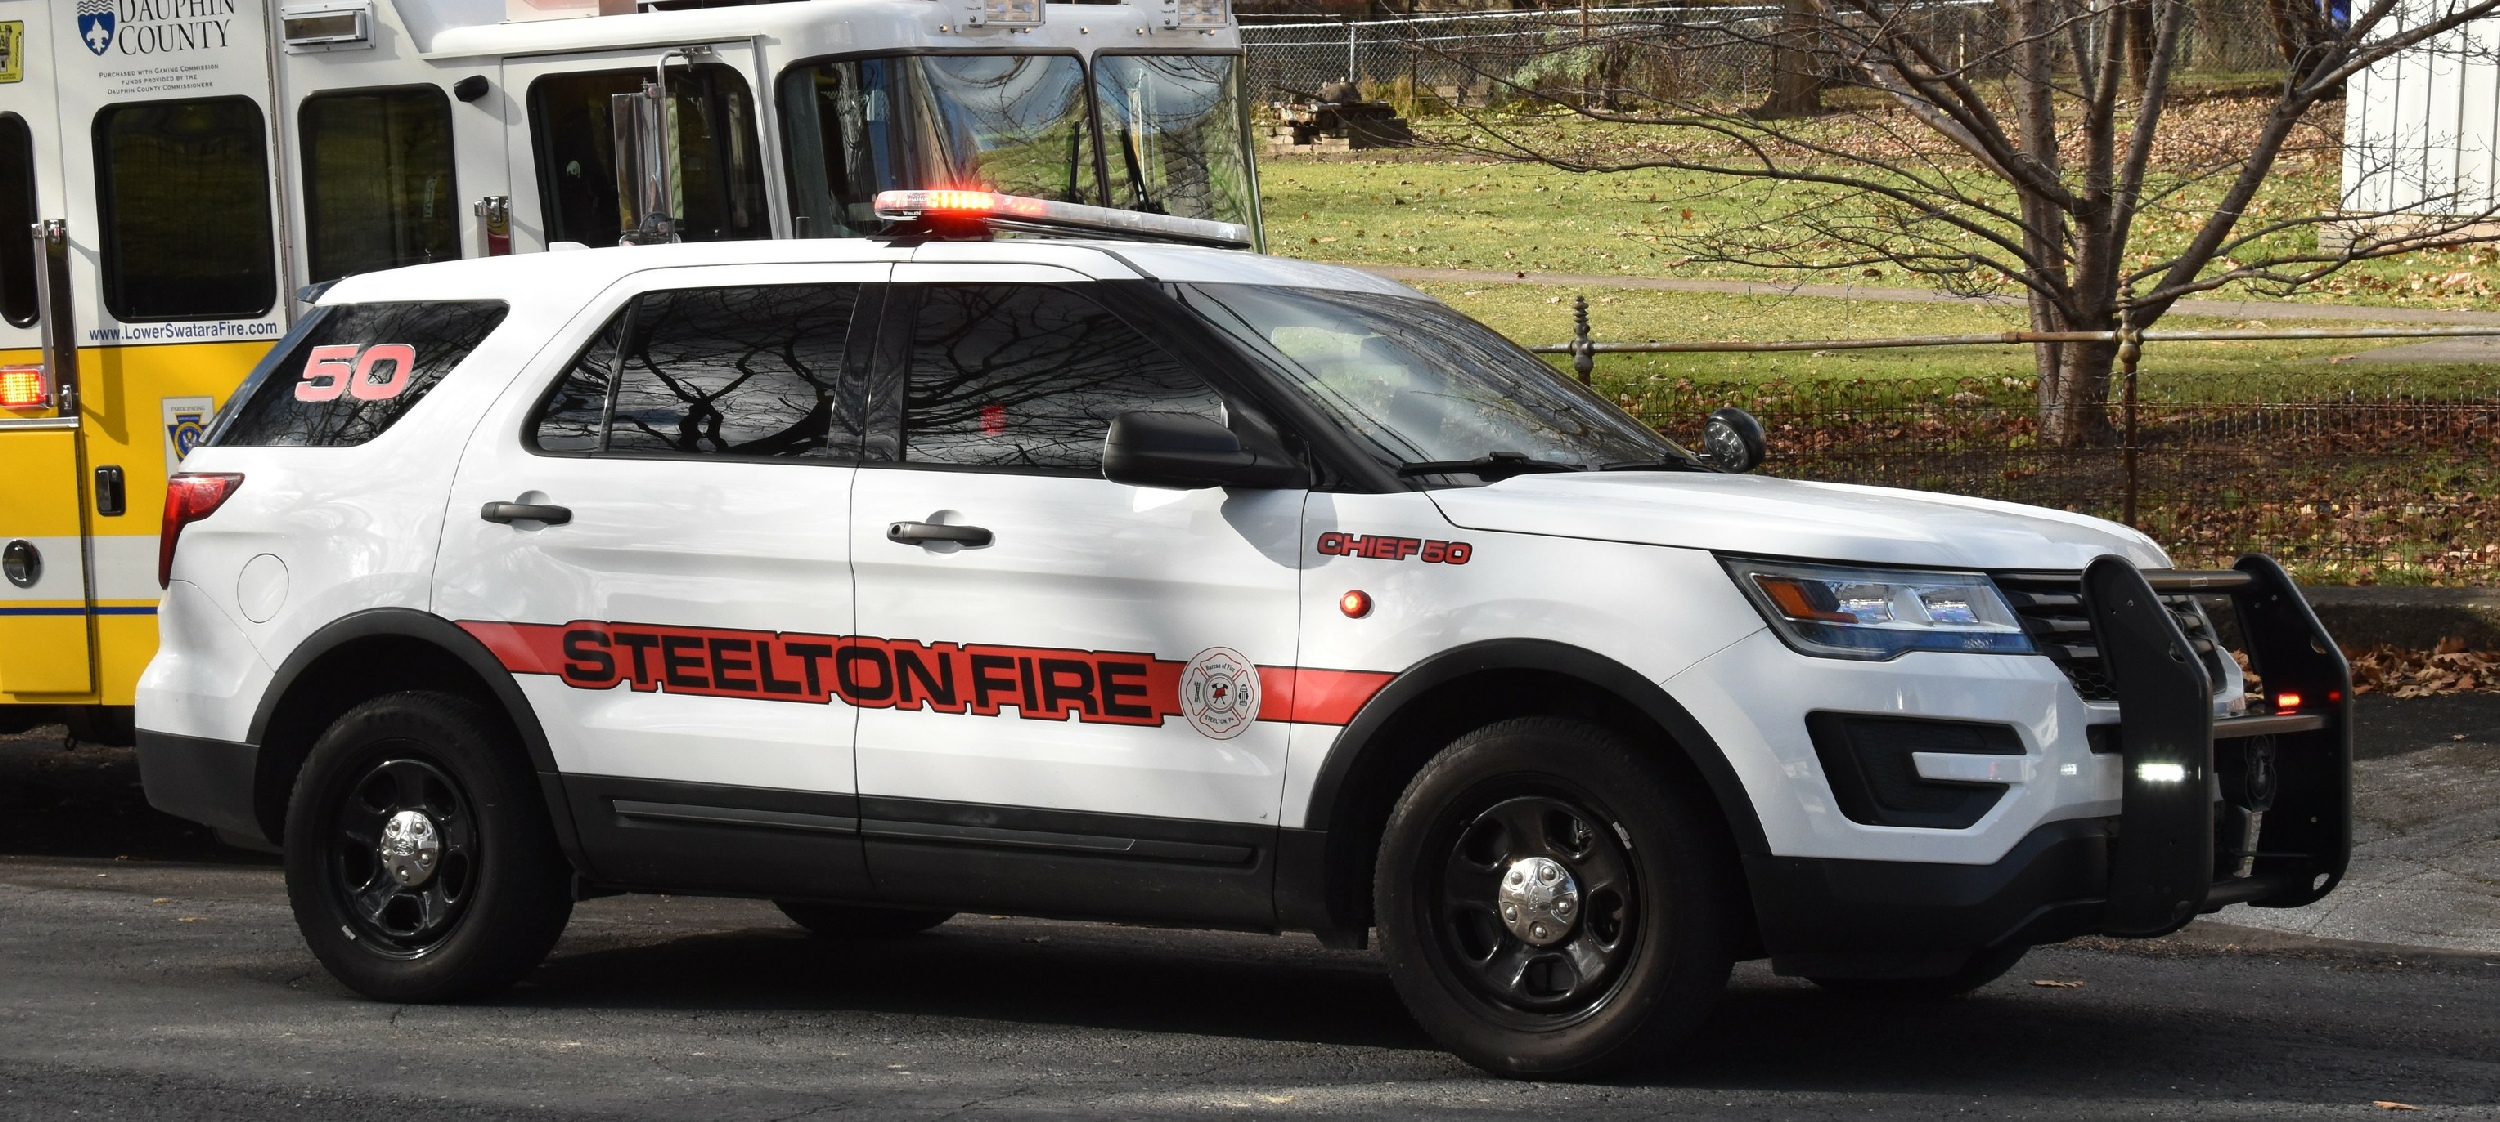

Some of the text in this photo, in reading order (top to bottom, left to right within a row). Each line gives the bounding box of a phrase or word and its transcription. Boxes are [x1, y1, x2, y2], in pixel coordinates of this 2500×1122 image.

[118, 19, 231, 56] COUNTY
[180, 64, 219, 72] COMMISSION
[162, 82, 213, 91] COMMISSIONERS
[89, 321, 278, 341] www.LowerSwataraFire.com
[294, 343, 416, 402] 50
[1317, 531, 1473, 565] CHIEF 50
[562, 629, 1153, 719] STEELTON FIRE
